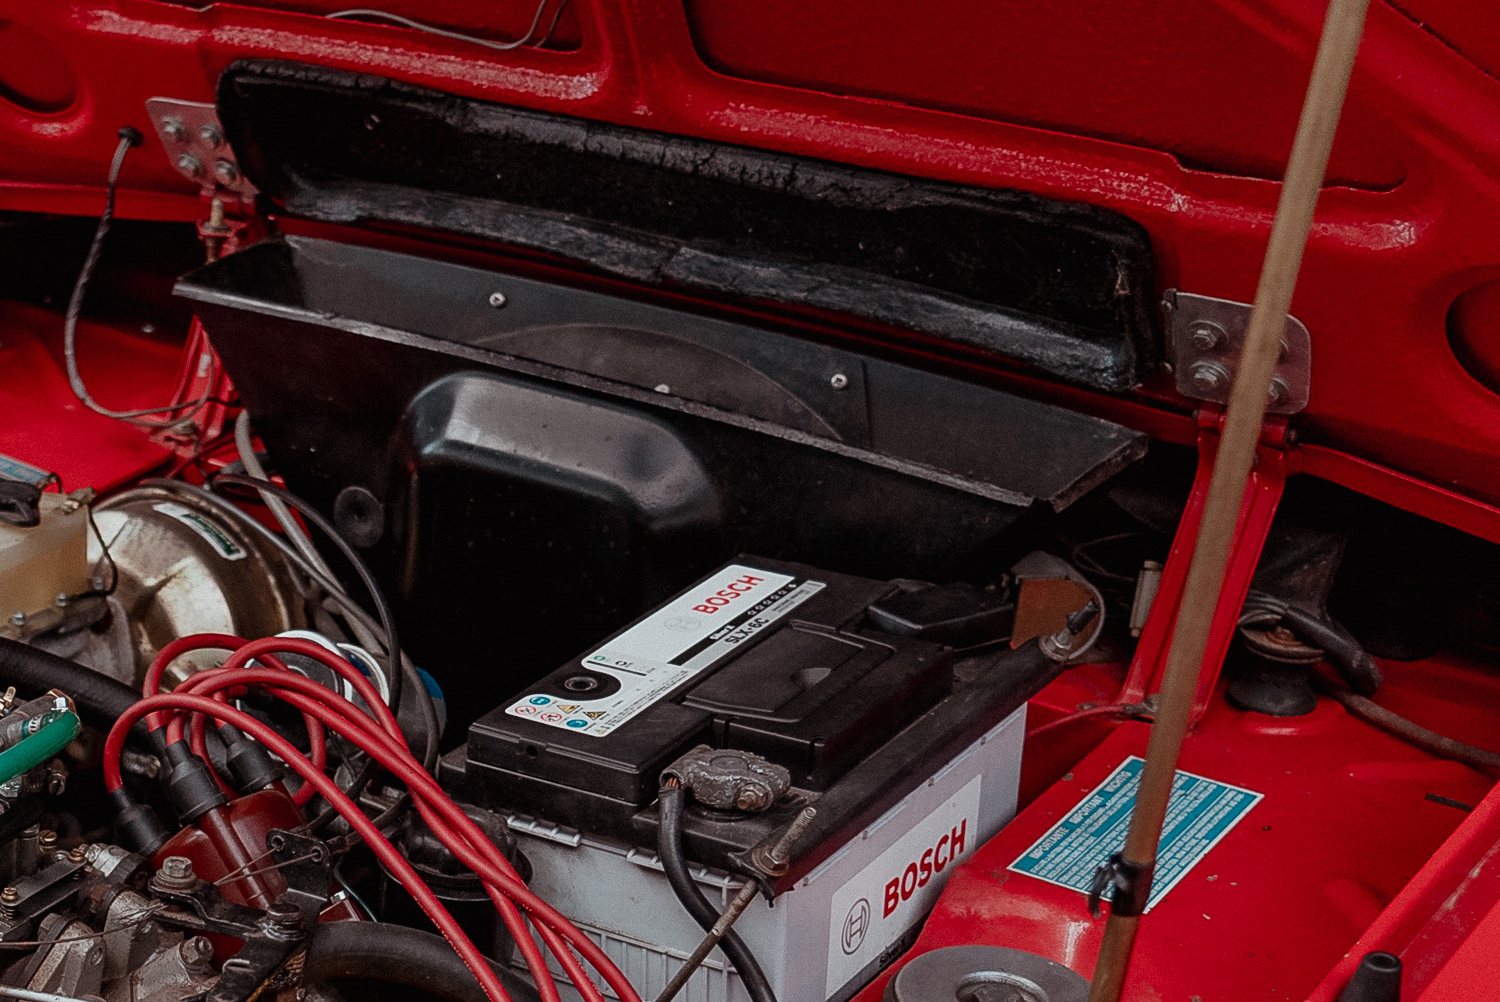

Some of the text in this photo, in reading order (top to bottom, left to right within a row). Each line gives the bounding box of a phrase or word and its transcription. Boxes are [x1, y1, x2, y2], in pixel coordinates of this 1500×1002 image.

[692, 575, 764, 614] BOSCH
[1028, 826, 1070, 860] IMPORTANTE
[1068, 795, 1105, 825] IMPORTANT
[882, 818, 967, 920] BOSCH
